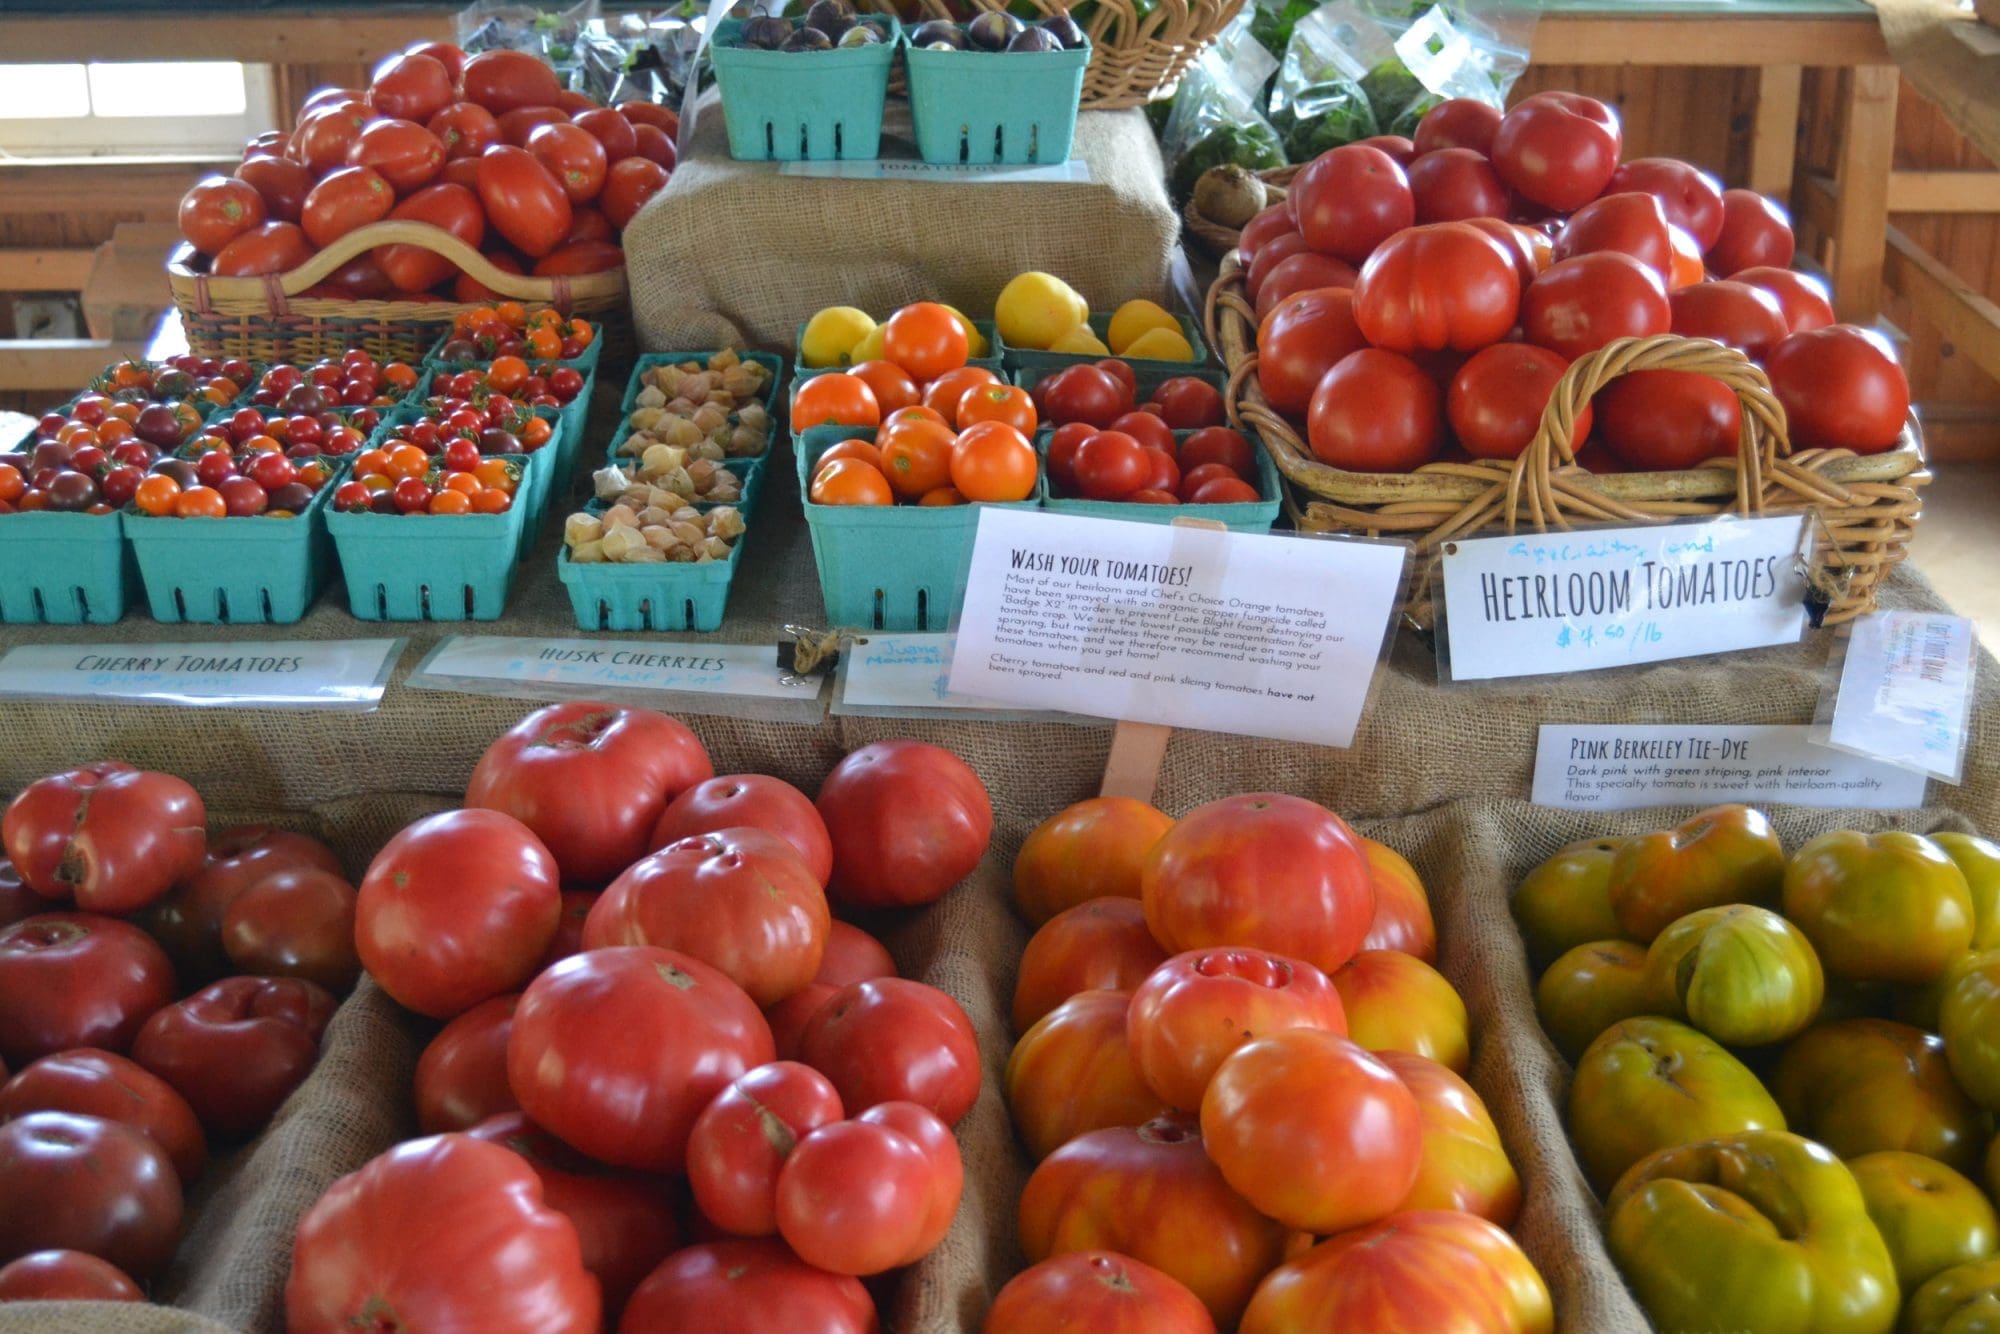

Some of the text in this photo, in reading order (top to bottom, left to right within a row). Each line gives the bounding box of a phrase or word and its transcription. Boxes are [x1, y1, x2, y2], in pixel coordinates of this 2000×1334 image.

[1011, 548, 1192, 587] WASH YOUR TOMATOES!
[1004, 583, 1030, 594] have
[1034, 586, 1061, 597] been
[1065, 593, 1109, 603] sprayed
[1114, 597, 1136, 605] with
[1158, 603, 1197, 613] organic
[1201, 608, 1238, 618] copper
[1243, 610, 1291, 624] fungicide
[1294, 618, 1326, 629] called
[1006, 573, 1034, 584] Most
[1037, 577, 1049, 585] of
[1075, 580, 1121, 593] heirloom
[1126, 588, 1147, 596] and
[1188, 592, 1224, 605] Choice
[1228, 598, 1271, 613] Orange
[1275, 604, 1324, 617] tomatoes
[1480, 555, 1777, 622] HEIRLOOM TOMATOES
[997, 616, 1046, 629] spraying,
[1051, 619, 1069, 629] but
[1073, 625, 1138, 637] nevertheless
[1143, 629, 1169, 640] there
[1174, 636, 1197, 645] may
[1202, 636, 1215, 646] be
[1219, 642, 1257, 651] residue
[1278, 650, 1305, 658] some
[1308, 651, 1322, 660] of
[1000, 605, 1038, 616] tomato
[1072, 612, 1093, 622] We
[1119, 617, 1136, 626] the
[1140, 618, 1175, 630] lowest
[1177, 626, 1219, 636] possible
[1223, 632, 1294, 646] concentration
[1298, 638, 1312, 648] for
[1081, 603, 1110, 613] order
[1115, 606, 1125, 614] to
[1127, 610, 1170, 621] prevent
[1174, 612, 1199, 623] Late
[1202, 616, 1233, 629] Blight
[1236, 620, 1262, 631] from
[1266, 624, 1322, 641] destroying
[75, 655, 304, 672] CHERRY TOMATOES
[538, 648, 728, 671] HUSK CHERRIES
[994, 634, 1042, 647] tomatoes
[1048, 640, 1077, 650] when
[1081, 647, 1100, 656] you
[1105, 648, 1122, 657] get
[996, 624, 1023, 635] these
[1083, 635, 1104, 643] and
[1129, 638, 1176, 651] therefore
[1180, 647, 1244, 661] recommend
[1248, 656, 1292, 669] washing
[1296, 662, 1320, 671] your
[988, 661, 1014, 672] been
[990, 653, 1315, 701] Cherry tomatoes and red and pink slicing tomatoes have not
[1570, 737, 1749, 760] PINK BERKELEY TIE-DYE
[1566, 777, 1883, 791] This specialty tomato is sweet with heirloom-quality
[1567, 764, 1598, 776] Dark
[1602, 764, 1628, 778] pink
[1634, 764, 1661, 776] with
[1664, 767, 1700, 778] green
[1757, 765, 1783, 779] pink
